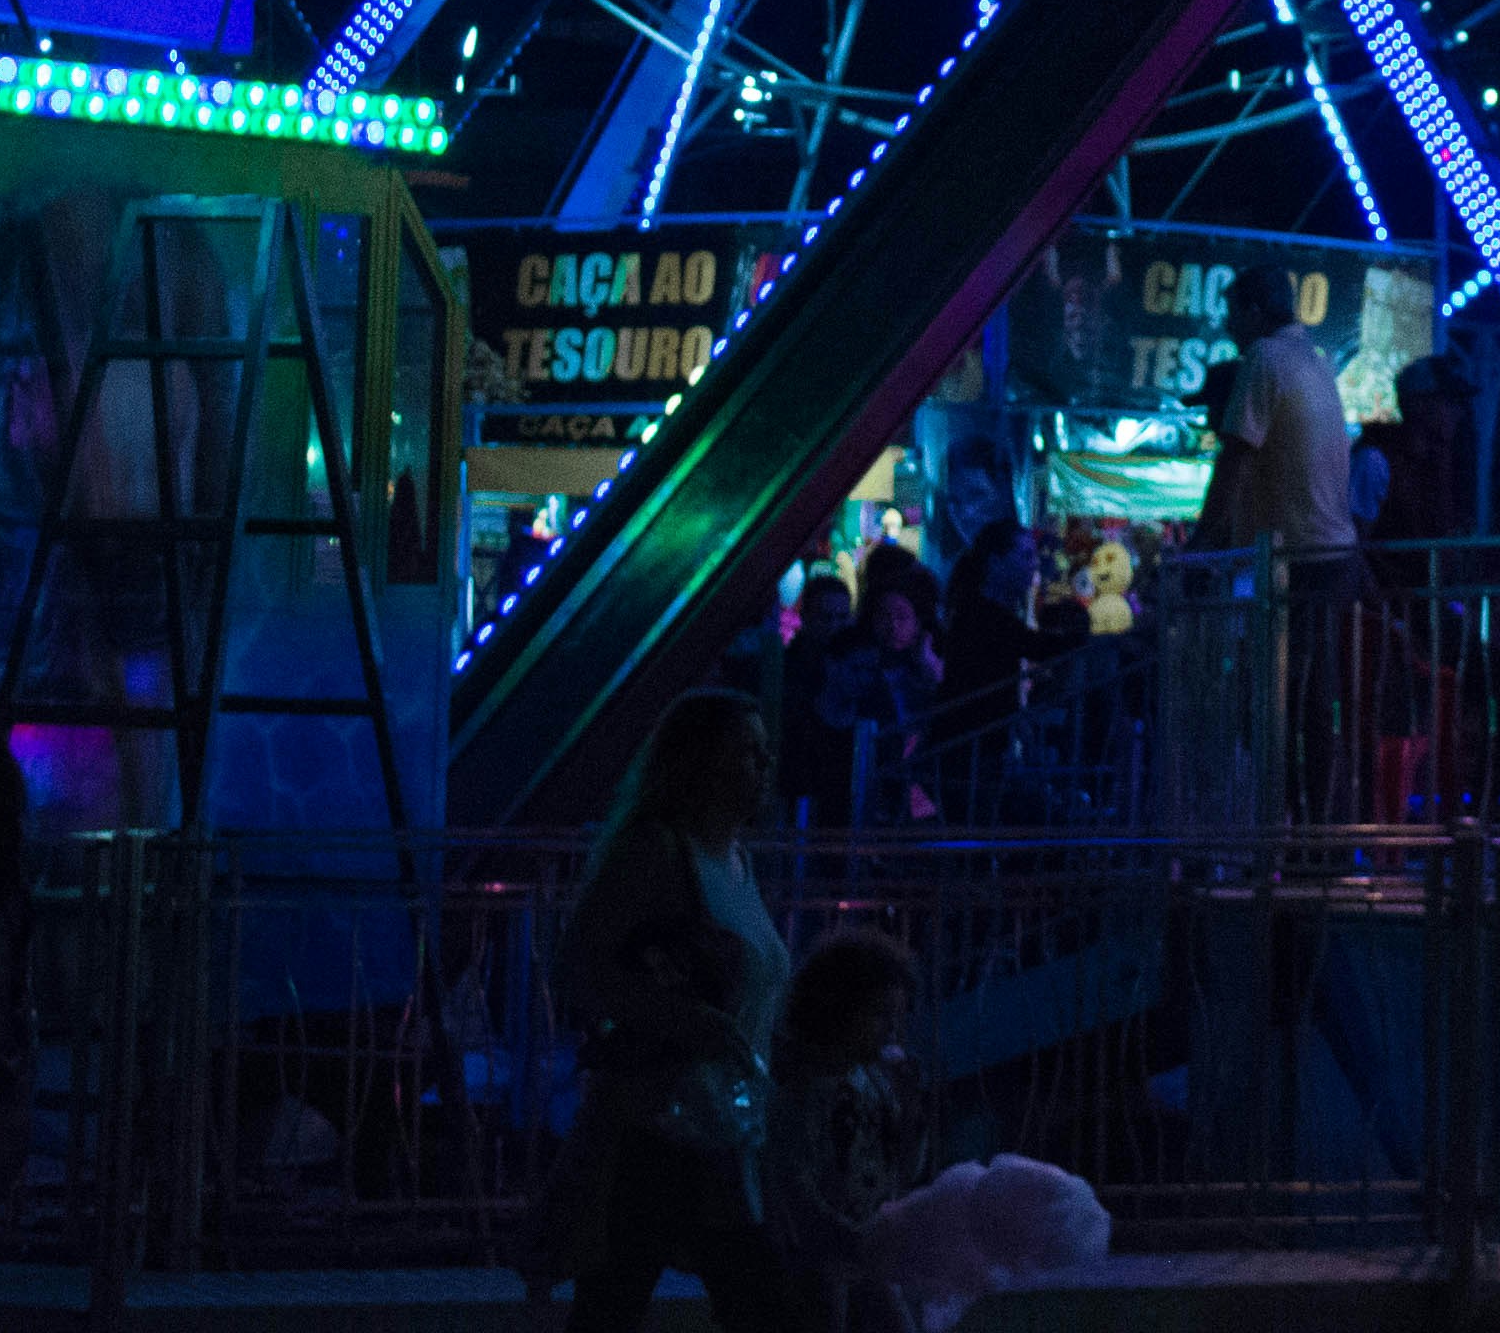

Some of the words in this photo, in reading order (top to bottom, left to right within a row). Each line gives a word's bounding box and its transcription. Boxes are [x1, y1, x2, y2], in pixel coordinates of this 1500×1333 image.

[515, 251, 642, 318] CAÇA
[648, 250, 718, 306] AO
[1142, 260, 1237, 328] CAÇ
[505, 325, 714, 384] TESOURO
